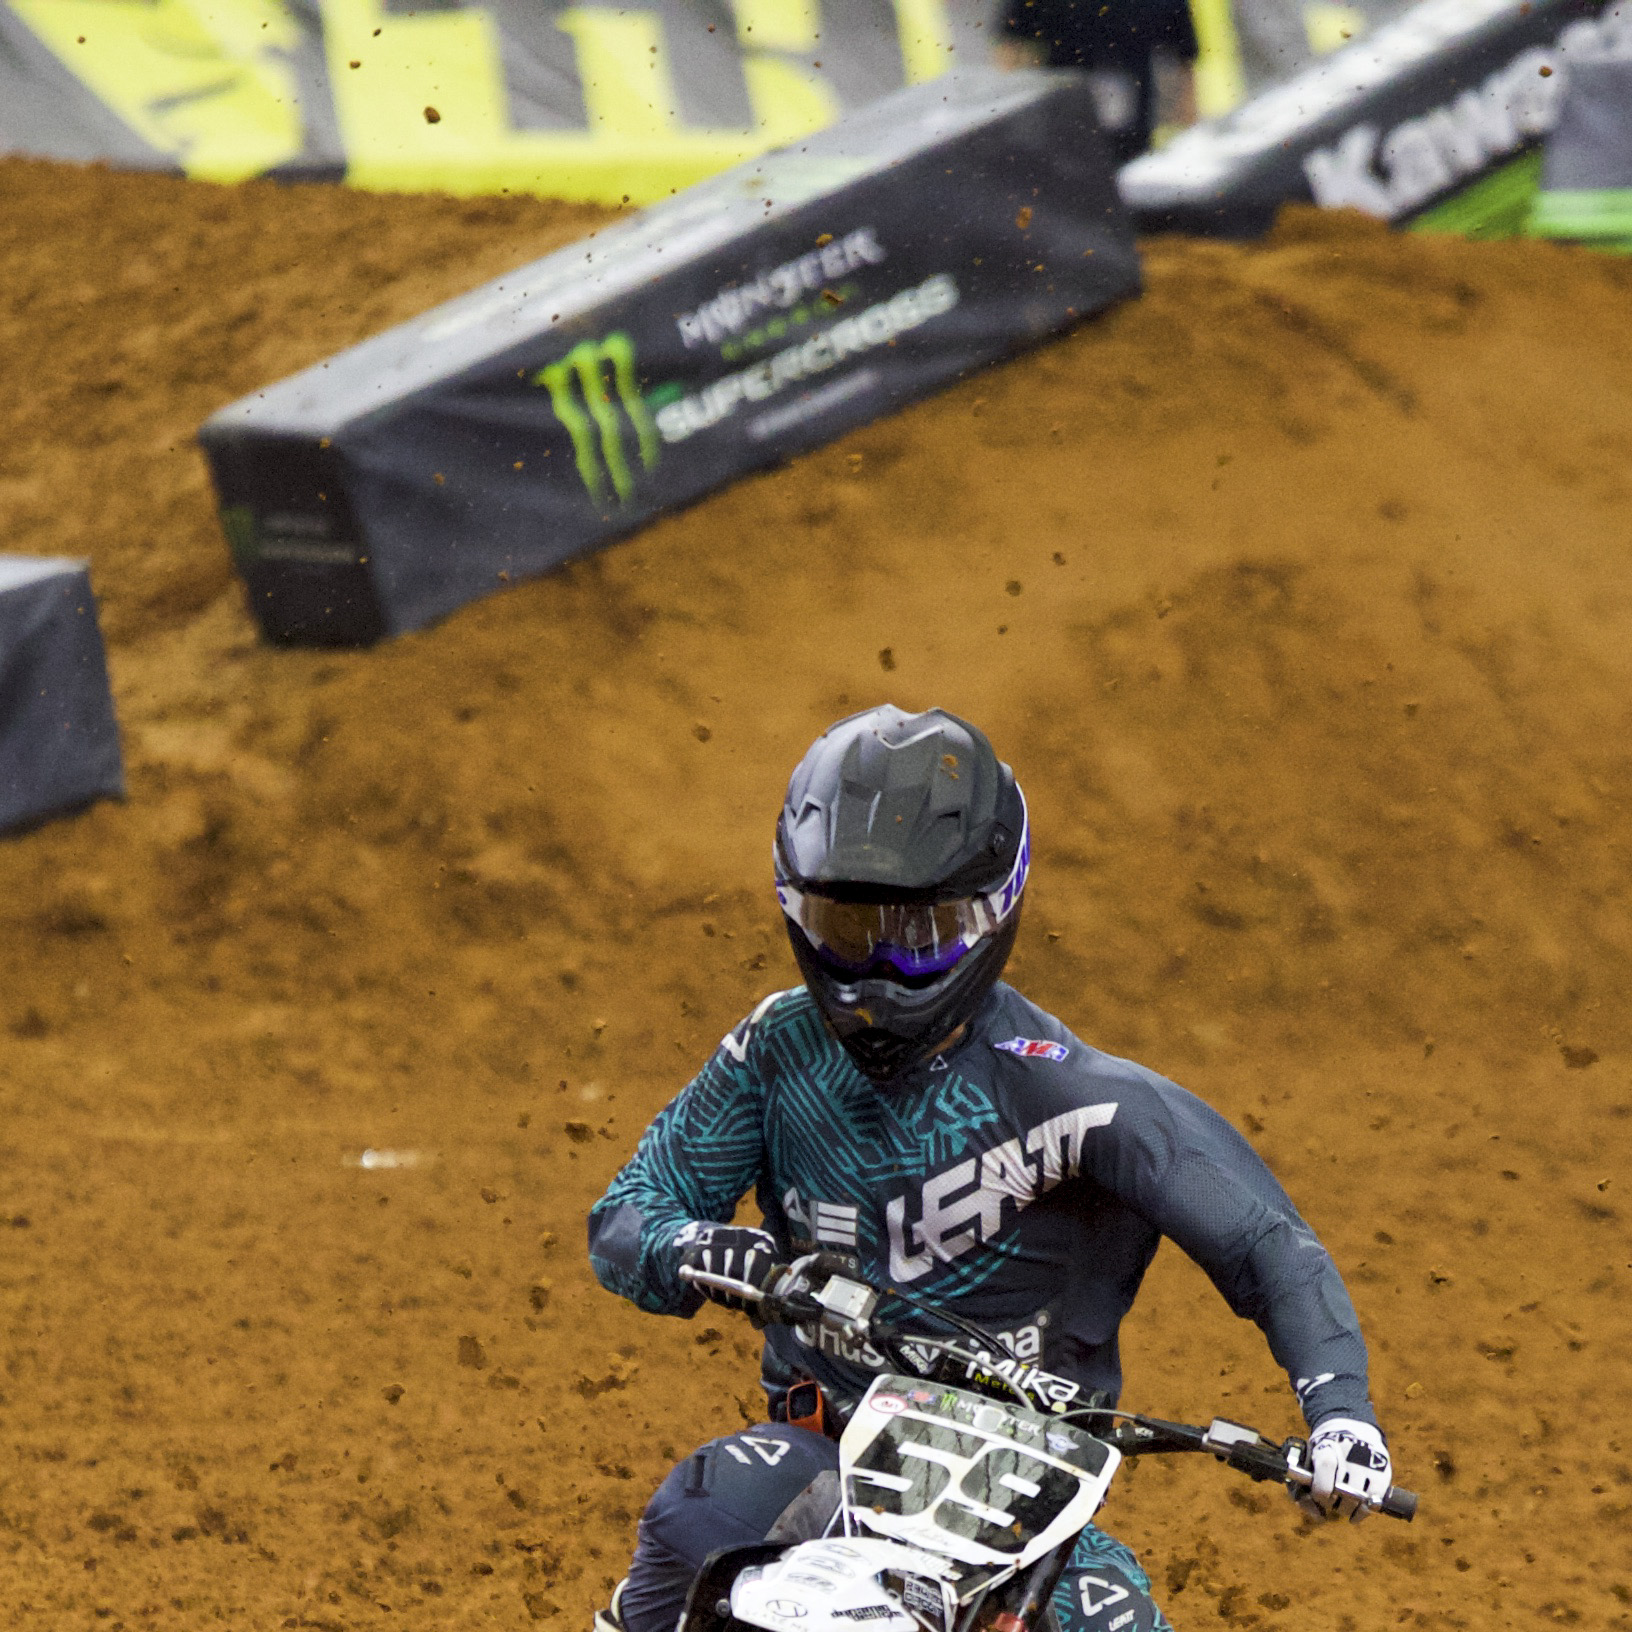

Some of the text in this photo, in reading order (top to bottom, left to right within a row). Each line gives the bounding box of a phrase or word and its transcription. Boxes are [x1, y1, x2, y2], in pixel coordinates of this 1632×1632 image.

[655, 273, 960, 442] SUPERCROSS
[676, 227, 886, 348] MONSTER
[886, 1102, 1118, 1283] LEATT
